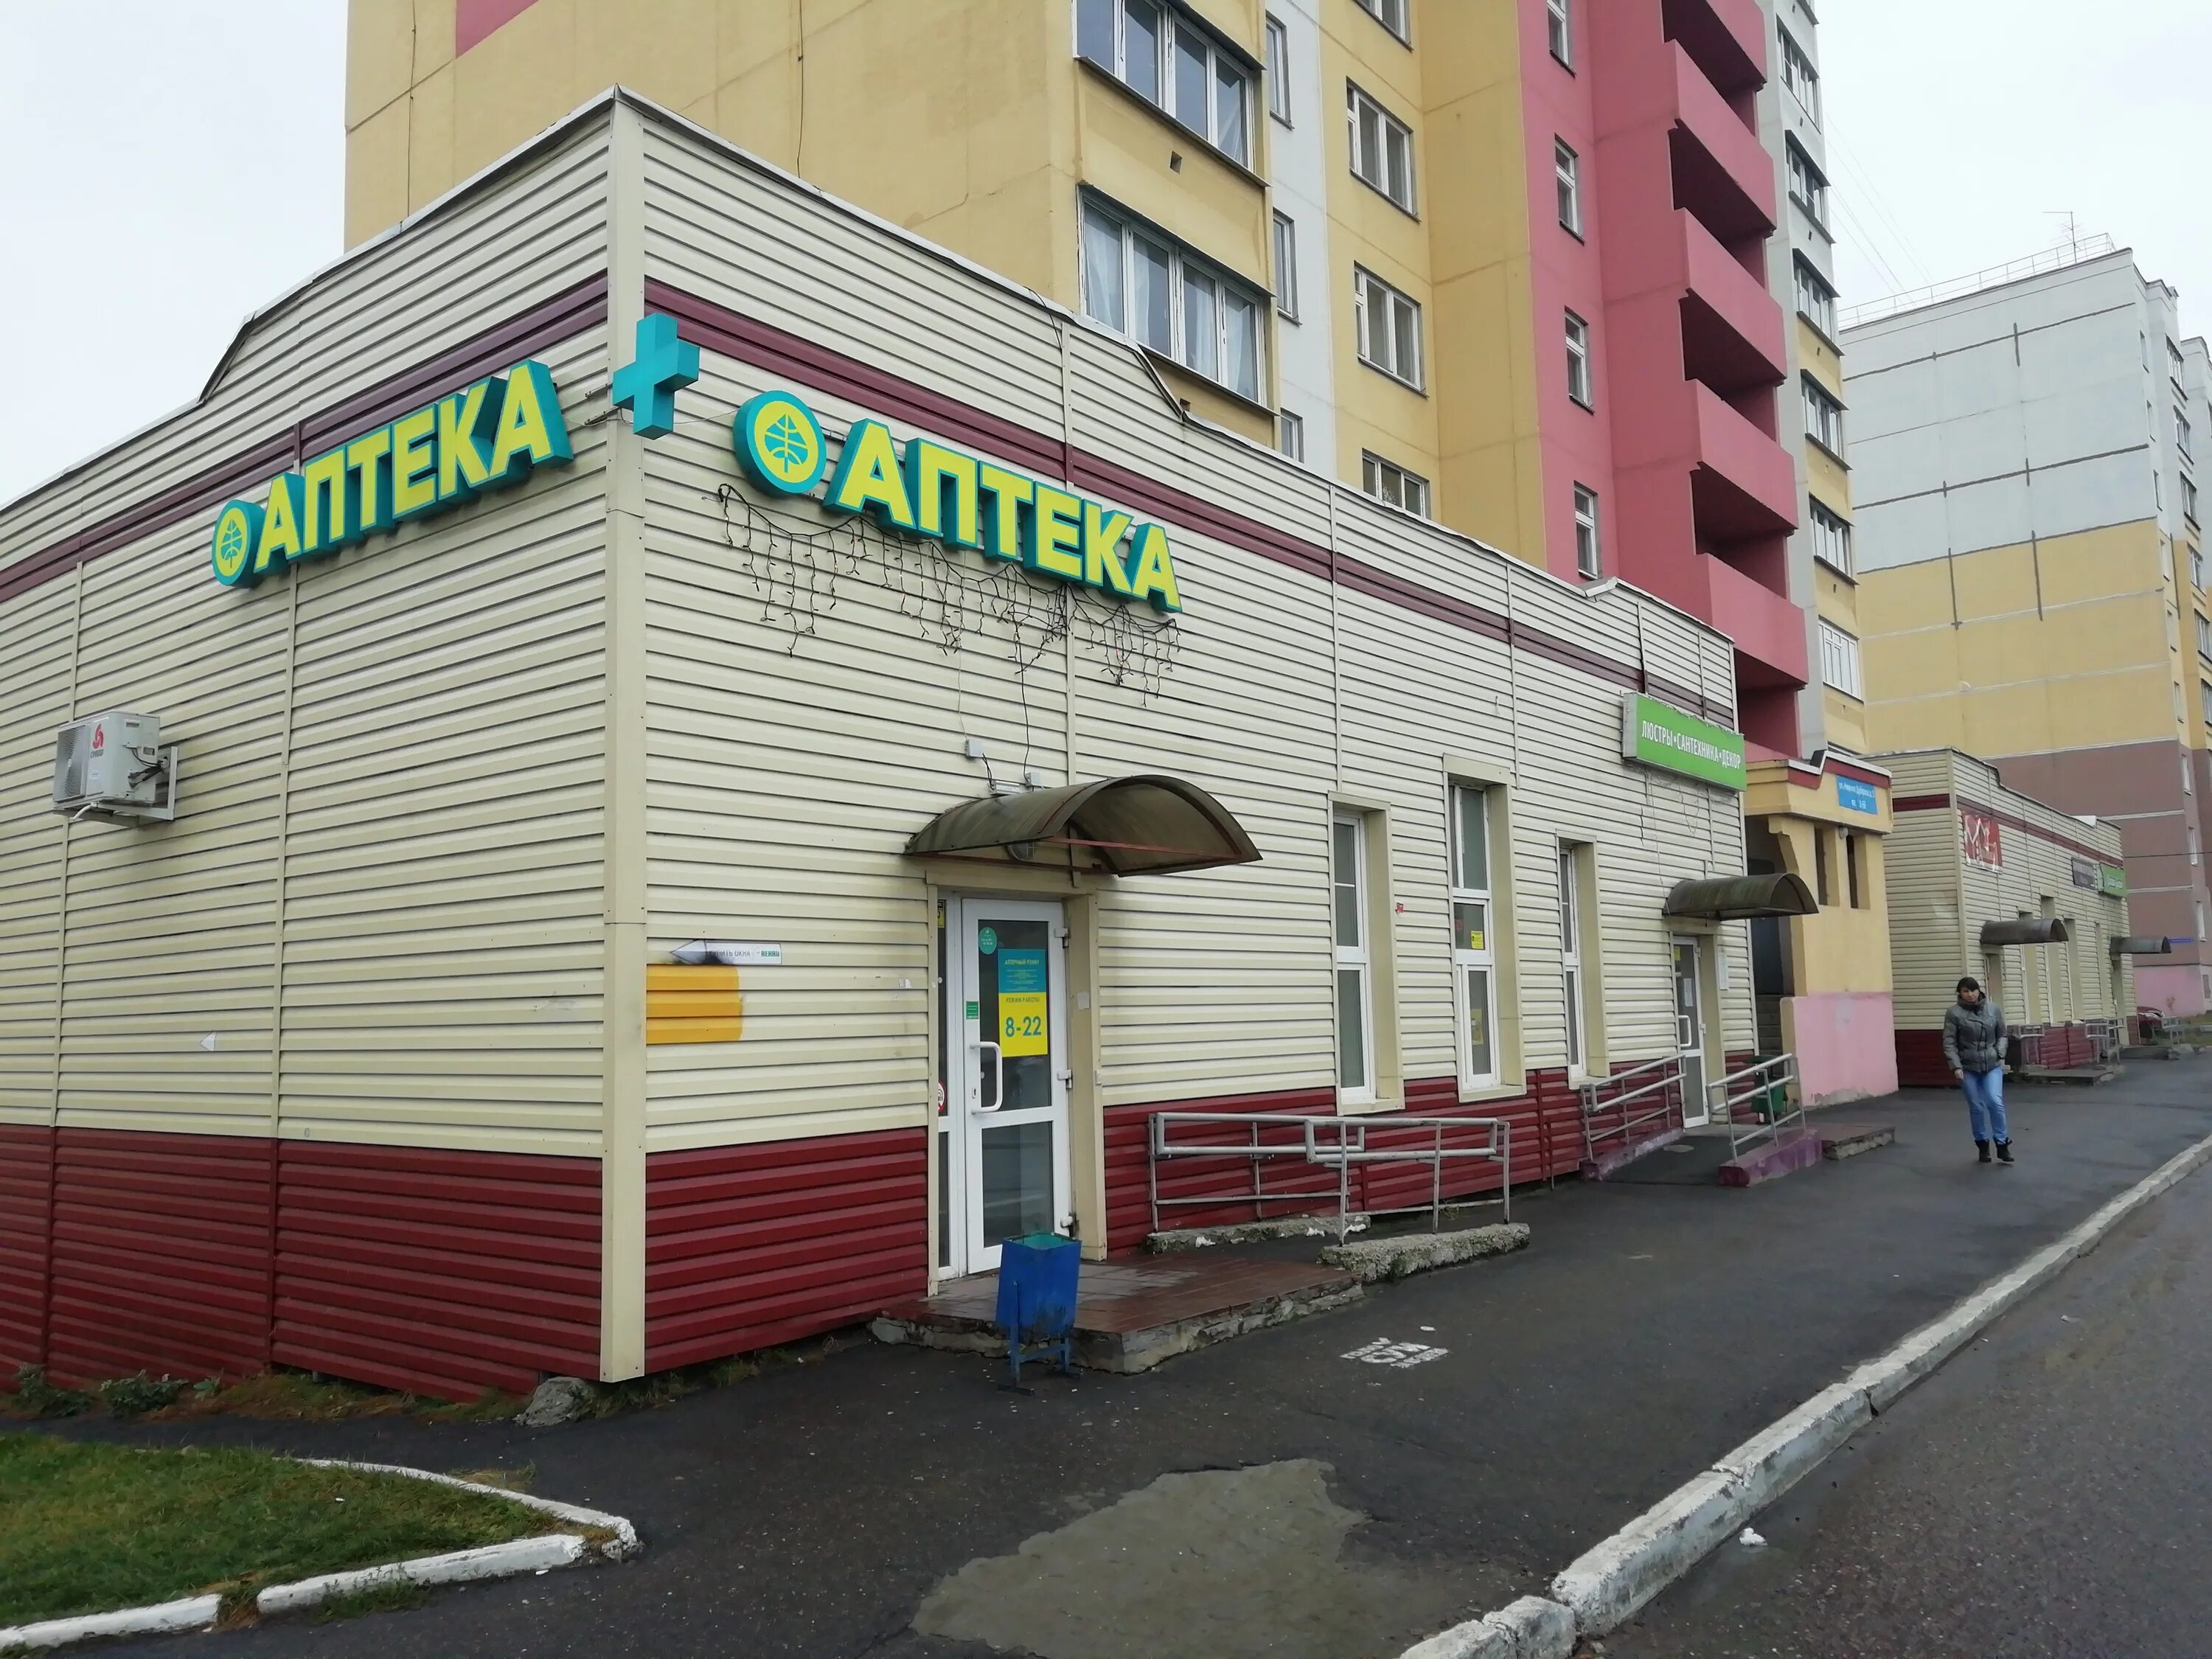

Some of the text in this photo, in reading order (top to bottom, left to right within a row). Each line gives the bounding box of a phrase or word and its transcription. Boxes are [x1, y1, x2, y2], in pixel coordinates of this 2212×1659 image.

[254, 358, 574, 574] АПТЕКА
[824, 418, 1183, 613] АПТЕКА
[1641, 720, 1741, 769] ЛЮСТРЫ САНТЕХНИКА ДЕКОР
[1005, 1016, 1042, 1037] 8-22
